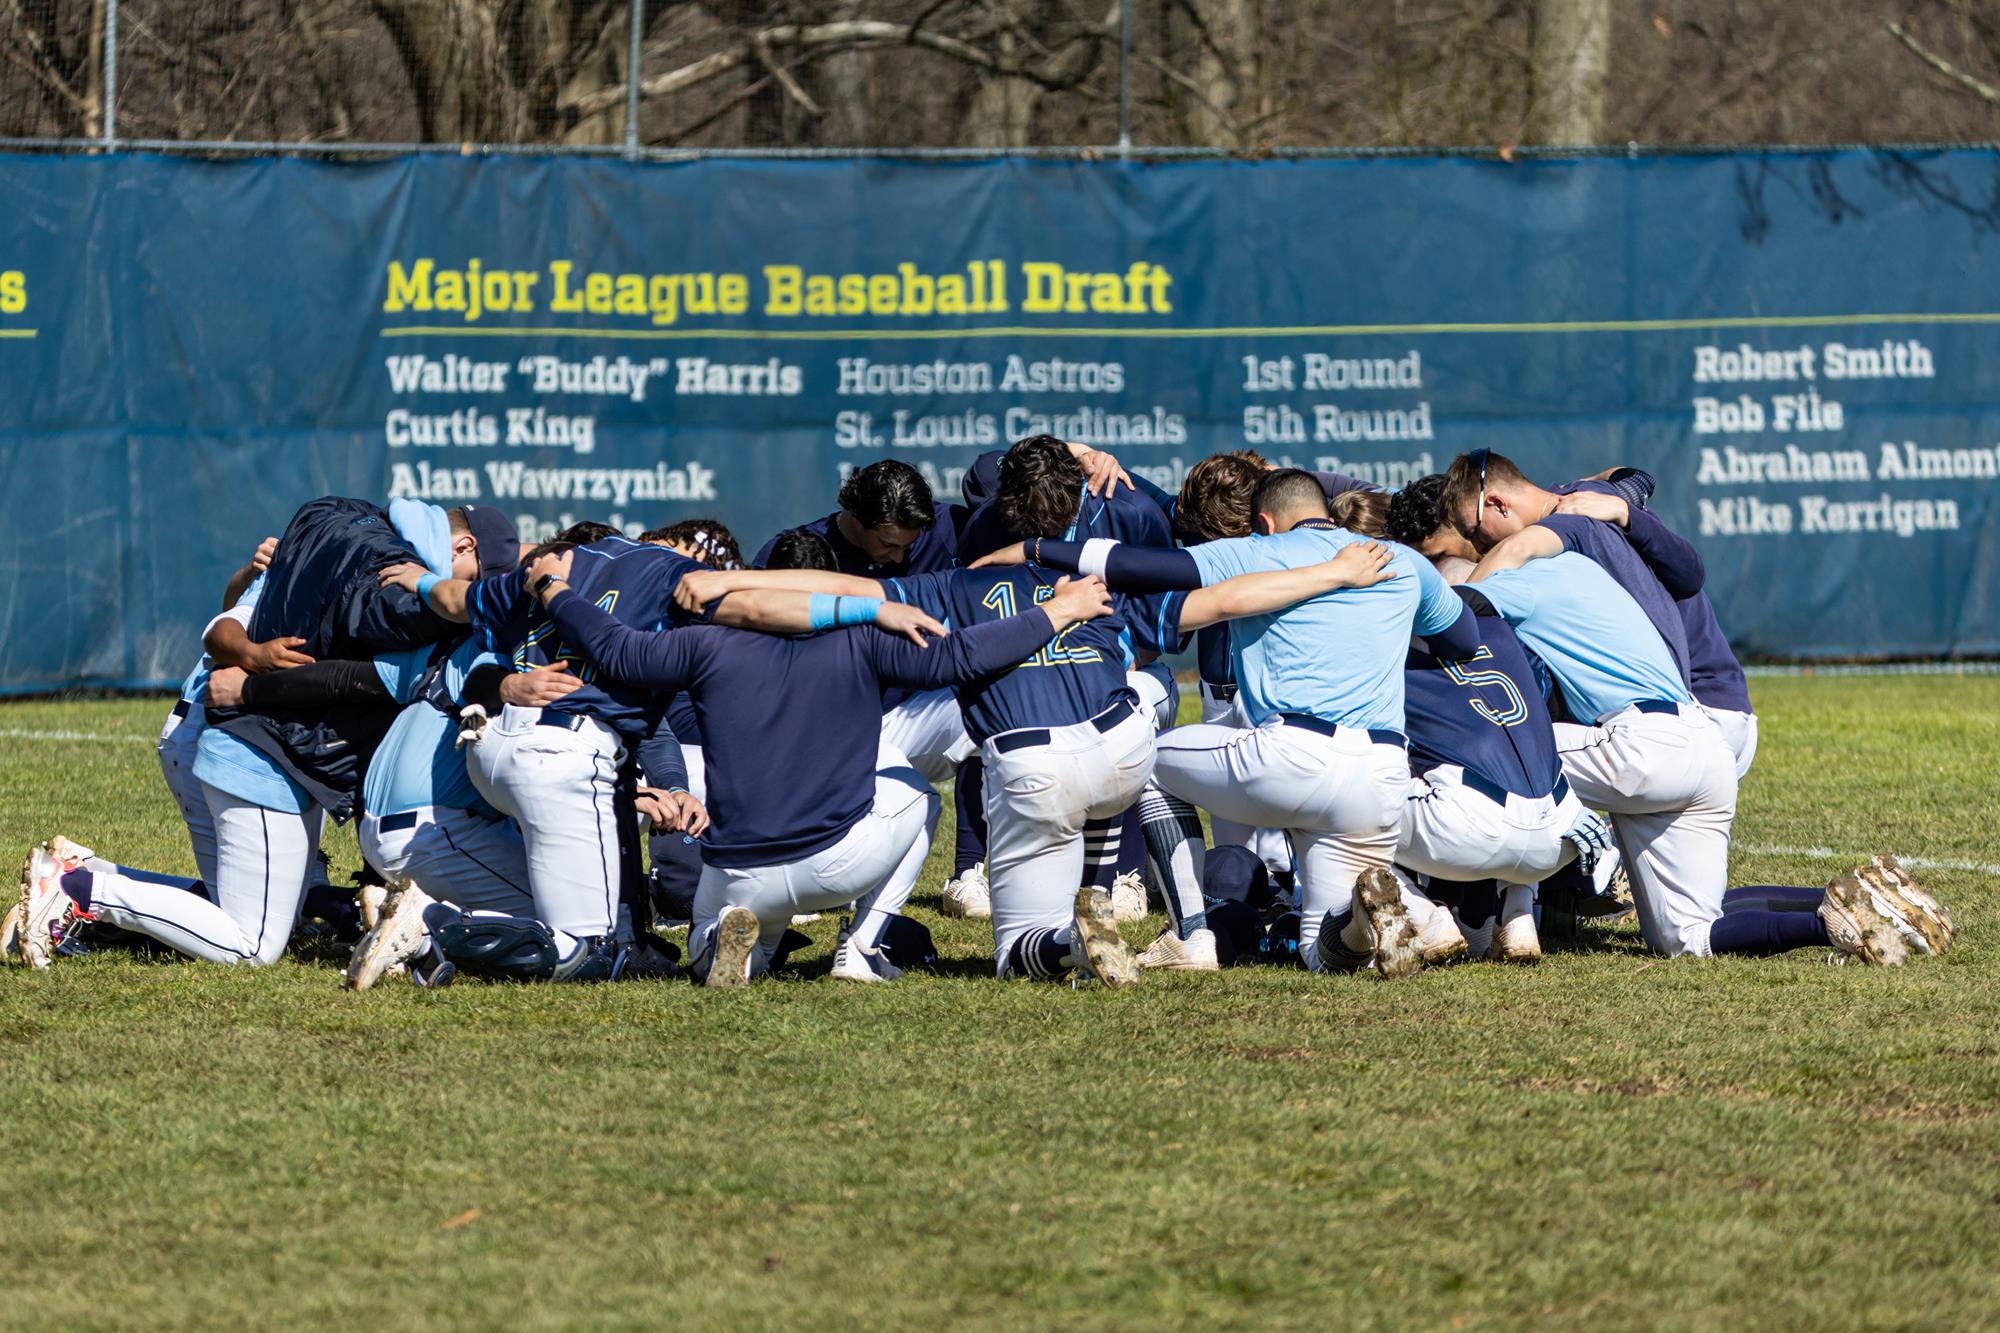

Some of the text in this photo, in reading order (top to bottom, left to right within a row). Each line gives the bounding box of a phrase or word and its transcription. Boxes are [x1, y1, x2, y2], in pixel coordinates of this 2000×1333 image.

[383, 257, 1173, 326] Major League Baseball Draft
[385, 353, 511, 394] Walter
[674, 356, 803, 396] Harris
[835, 353, 1125, 396] Houston Astros
[1241, 350, 1422, 392] 1st Round
[1692, 340, 1936, 383] Robert Smith
[384, 406, 596, 454] Curtis King
[833, 405, 1188, 449] St. Louis Cardinals
[1243, 401, 1434, 444] 5th Round
[1692, 385, 1845, 434] Bob File
[387, 460, 718, 507] Alan Wawrzyniak
[1695, 444, 1871, 485] Abraham
[1698, 492, 1961, 538] Mike Kerrigan
[1436, 644, 1529, 727] 5
